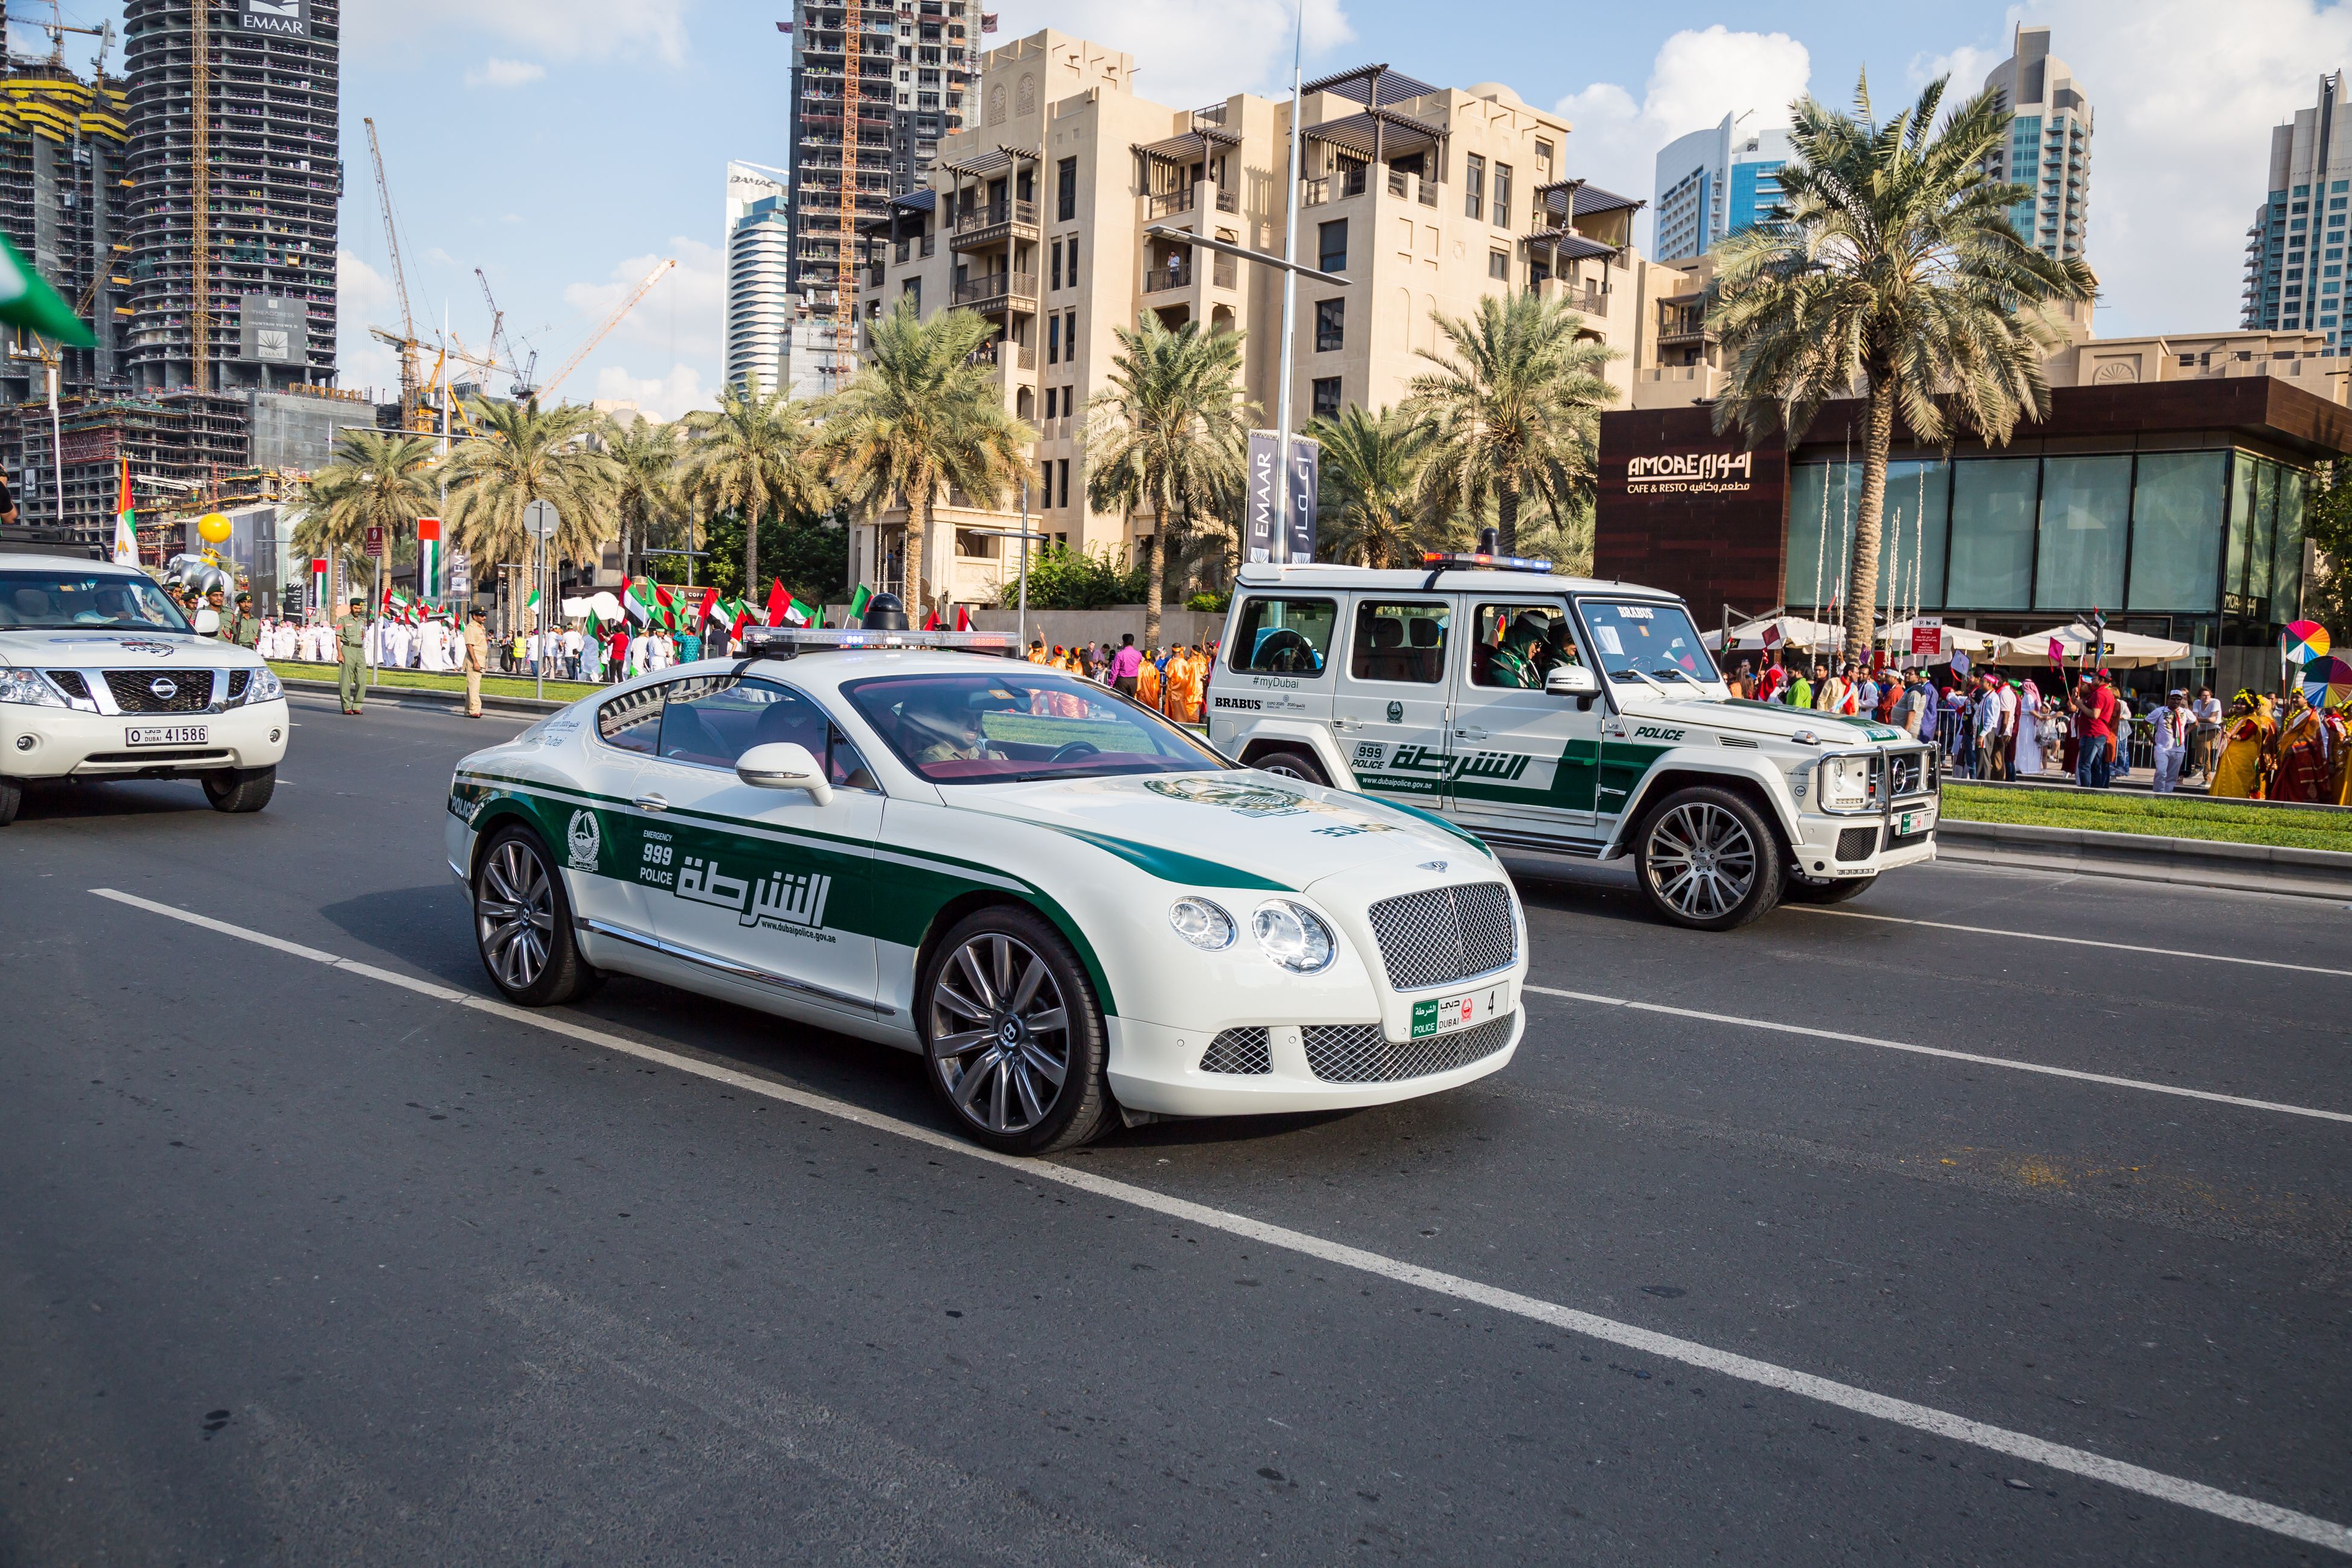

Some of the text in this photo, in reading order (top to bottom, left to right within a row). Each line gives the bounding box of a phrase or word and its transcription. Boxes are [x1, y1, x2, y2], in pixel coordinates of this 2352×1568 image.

[244, 14, 305, 35] EMAAR
[1627, 482, 1688, 494] CAFE & RESTO
[1689, 481, 1750, 494] مطعم وكافيه
[1255, 452, 1271, 538] EMAAR
[1617, 606, 1654, 619] BRABUS
[1253, 676, 1299, 689] #myDubai
[1215, 697, 1261, 710] BRABUS
[165, 728, 206, 742] 41586
[1634, 726, 1686, 741] POLICE
[1358, 747, 1382, 758] 999
[1351, 759, 1385, 770] POLICE
[1389, 744, 1532, 781] الشرطة
[1362, 777, 1432, 789] www.dubaipolice.gov.ae
[452, 795, 476, 819] POLICE
[643, 830, 673, 842] EMERGENCY
[643, 843, 673, 866] 999
[640, 867, 673, 885] POLICE
[676, 856, 831, 926] الشرطة
[761, 920, 836, 944] www.dubaipolice.gov.ae
[1440, 1000, 1460, 1013] دبي
[1488, 990, 1494, 1015] 4
[1415, 1005, 1436, 1017] الشرطة
[1414, 1023, 1435, 1034] POLICE
[1439, 1017, 1459, 1029] DUBAI
